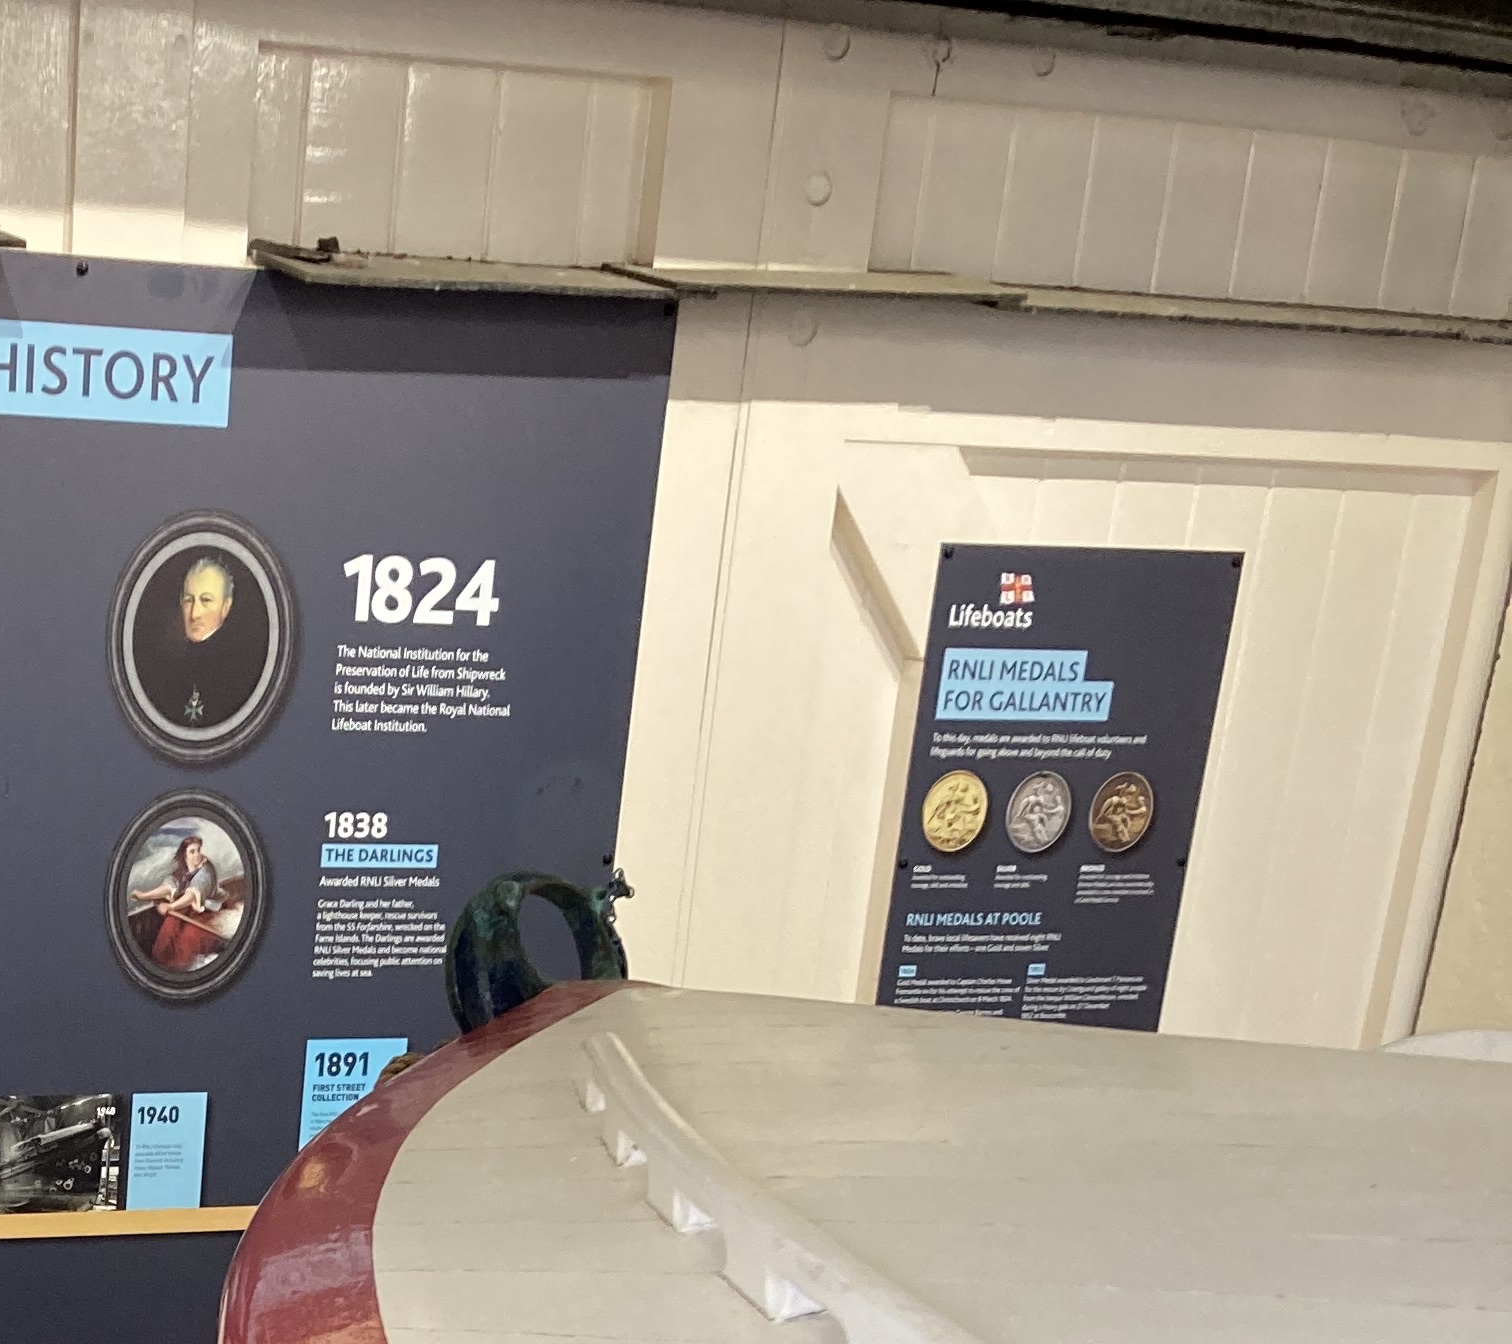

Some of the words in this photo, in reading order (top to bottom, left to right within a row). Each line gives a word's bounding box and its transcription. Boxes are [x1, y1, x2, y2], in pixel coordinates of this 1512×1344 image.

[343, 554, 500, 626] 1824
[948, 603, 1033, 628] Lifeboats
[337, 645, 355, 658] The
[358, 646, 401, 659] National
[404, 647, 454, 661] Institution
[456, 648, 471, 661] for
[473, 649, 489, 662] the
[336, 664, 397, 678] Preservation
[399, 665, 410, 678] of
[412, 665, 429, 679] Life
[431, 666, 454, 679] from
[457, 667, 506, 683] Shipwreck
[948, 659, 994, 680] RNLI
[1000, 660, 1080, 682] MEDALS
[334, 682, 342, 694] is
[344, 682, 385, 696] founded
[388, 683, 400, 699] by
[401, 684, 414, 696] Sir
[416, 685, 454, 697] William
[456, 686, 490, 701] Hillary.
[333, 700, 353, 713] This
[355, 700, 379, 713] later
[380, 701, 419, 715] became
[421, 702, 437, 715] the
[440, 703, 466, 718] Royal
[469, 704, 511, 717] National
[943, 690, 984, 711] FOR
[990, 691, 1106, 713] GALLANTRY
[332, 718, 372, 731] Lifeboat
[374, 719, 427, 732] Institution.
[325, 811, 387, 838] 1838
[326, 849, 354, 862] THE
[359, 849, 433, 863] DARLINGS
[319, 876, 359, 887] Awarded
[360, 876, 382, 887] RNLI
[384, 876, 407, 888] Silver
[408, 876, 440, 888] Medals
[906, 913, 935, 926] RNLI
[936, 912, 984, 926] MEDALS
[984, 913, 1001, 925] AT
[1002, 912, 1042, 926] POOLE
[315, 1052, 369, 1077] 1891
[313, 1084, 334, 1092] FIRST
[336, 1083, 365, 1091] STREET
[312, 1094, 359, 1102] COLLECTION
[97, 1107, 116, 1116] 1940
[138, 1106, 179, 1124] 1940
